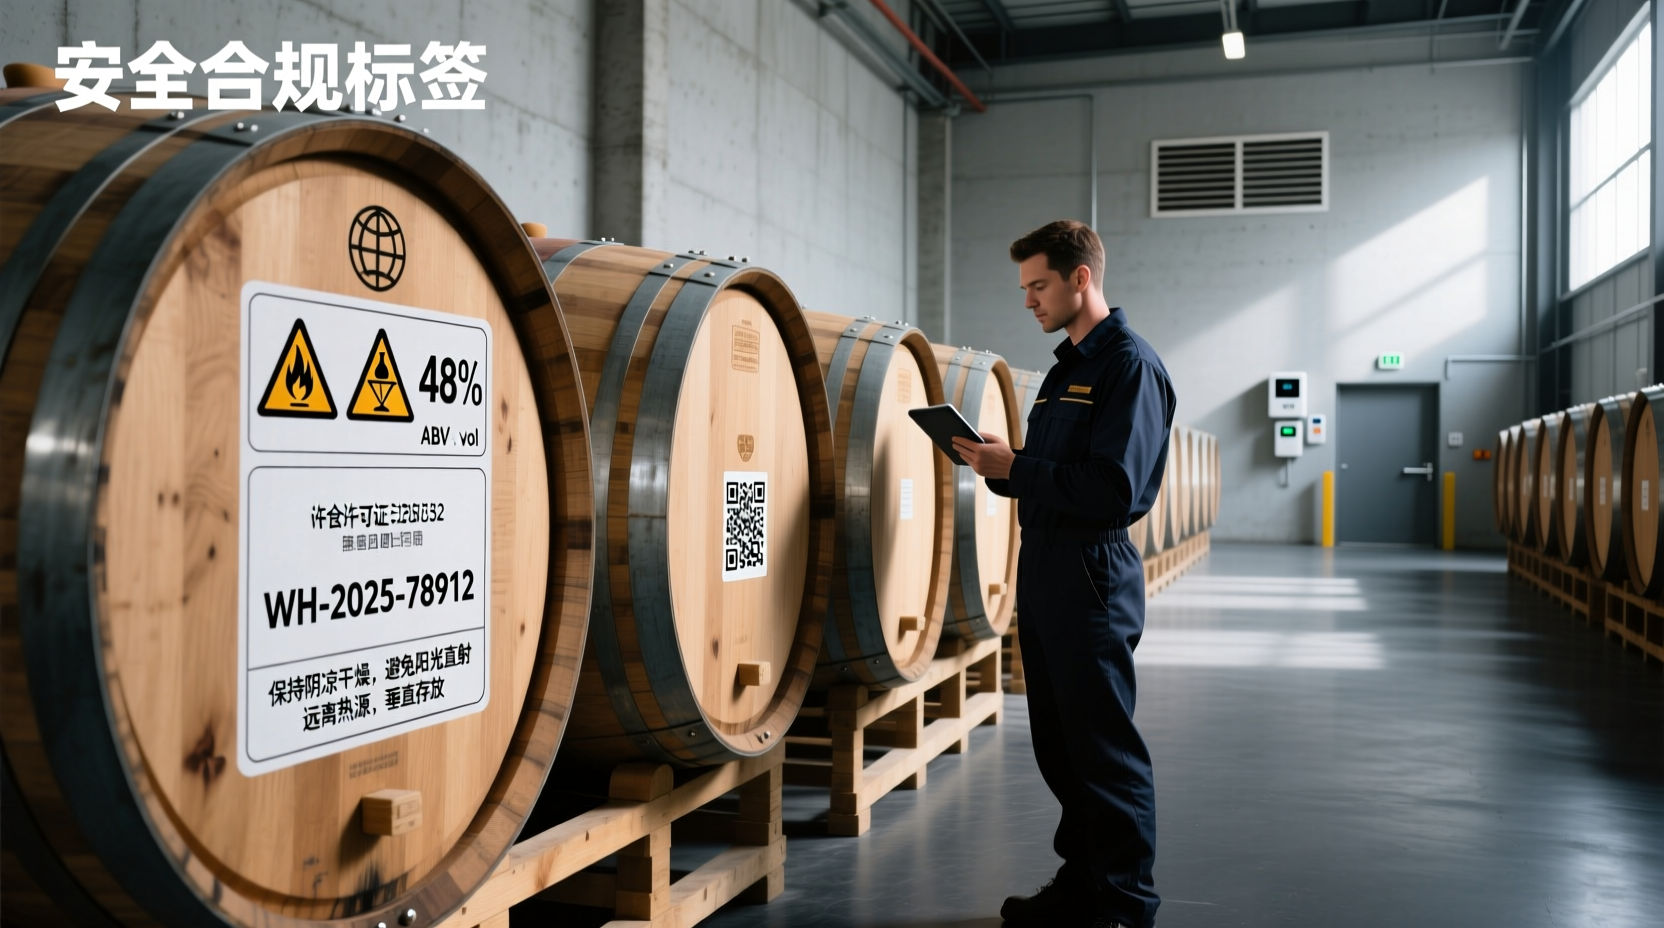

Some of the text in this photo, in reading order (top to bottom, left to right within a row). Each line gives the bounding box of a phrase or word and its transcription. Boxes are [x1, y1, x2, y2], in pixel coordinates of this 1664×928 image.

[419, 355, 483, 407] 48%
[420, 425, 450, 446] ABV
[263, 568, 475, 629] WH-2025-78912
